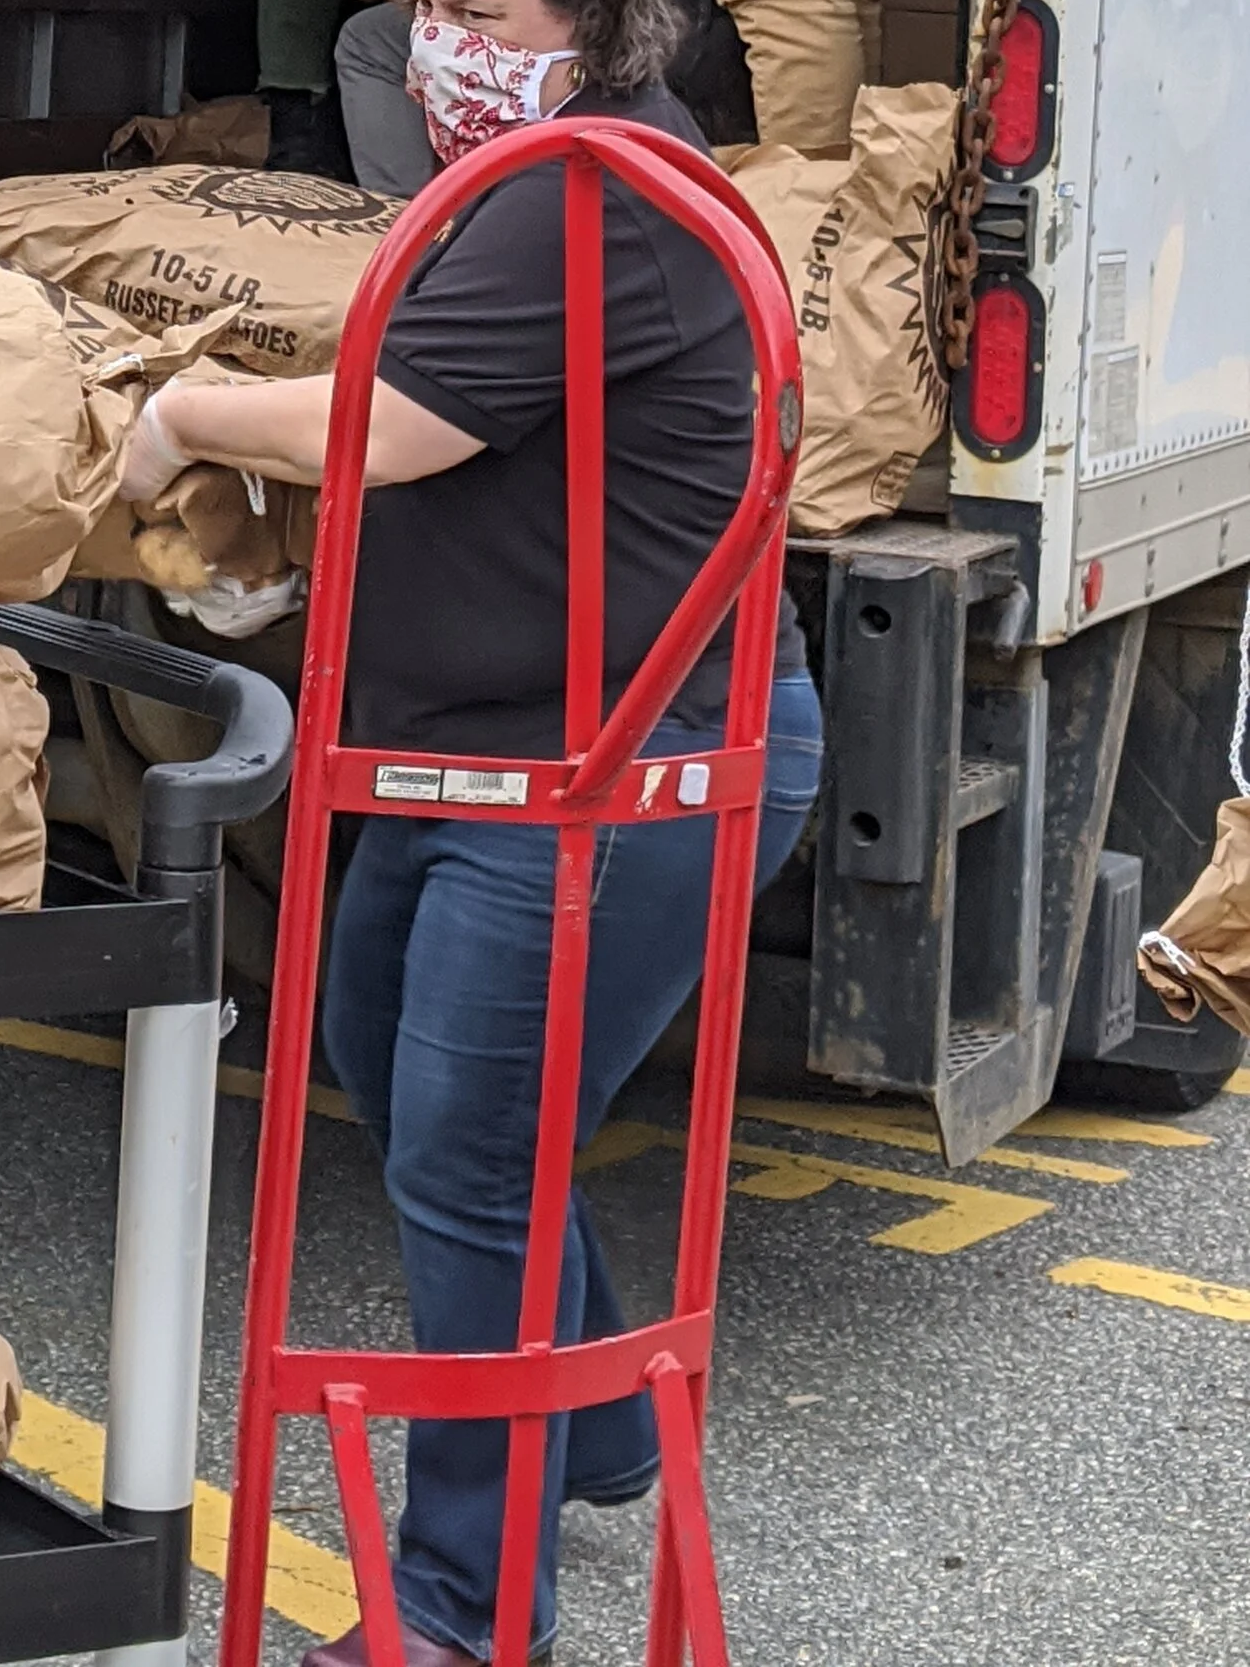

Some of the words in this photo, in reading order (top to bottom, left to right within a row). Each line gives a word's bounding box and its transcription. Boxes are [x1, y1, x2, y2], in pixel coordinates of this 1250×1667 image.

[151, 248, 218, 292] 10-5
[220, 273, 264, 310] LB.
[806, 208, 844, 282] 10-5
[105, 279, 184, 324] RUSSET
[188, 304, 298, 358] PATOES
[798, 289, 831, 337] LB.
